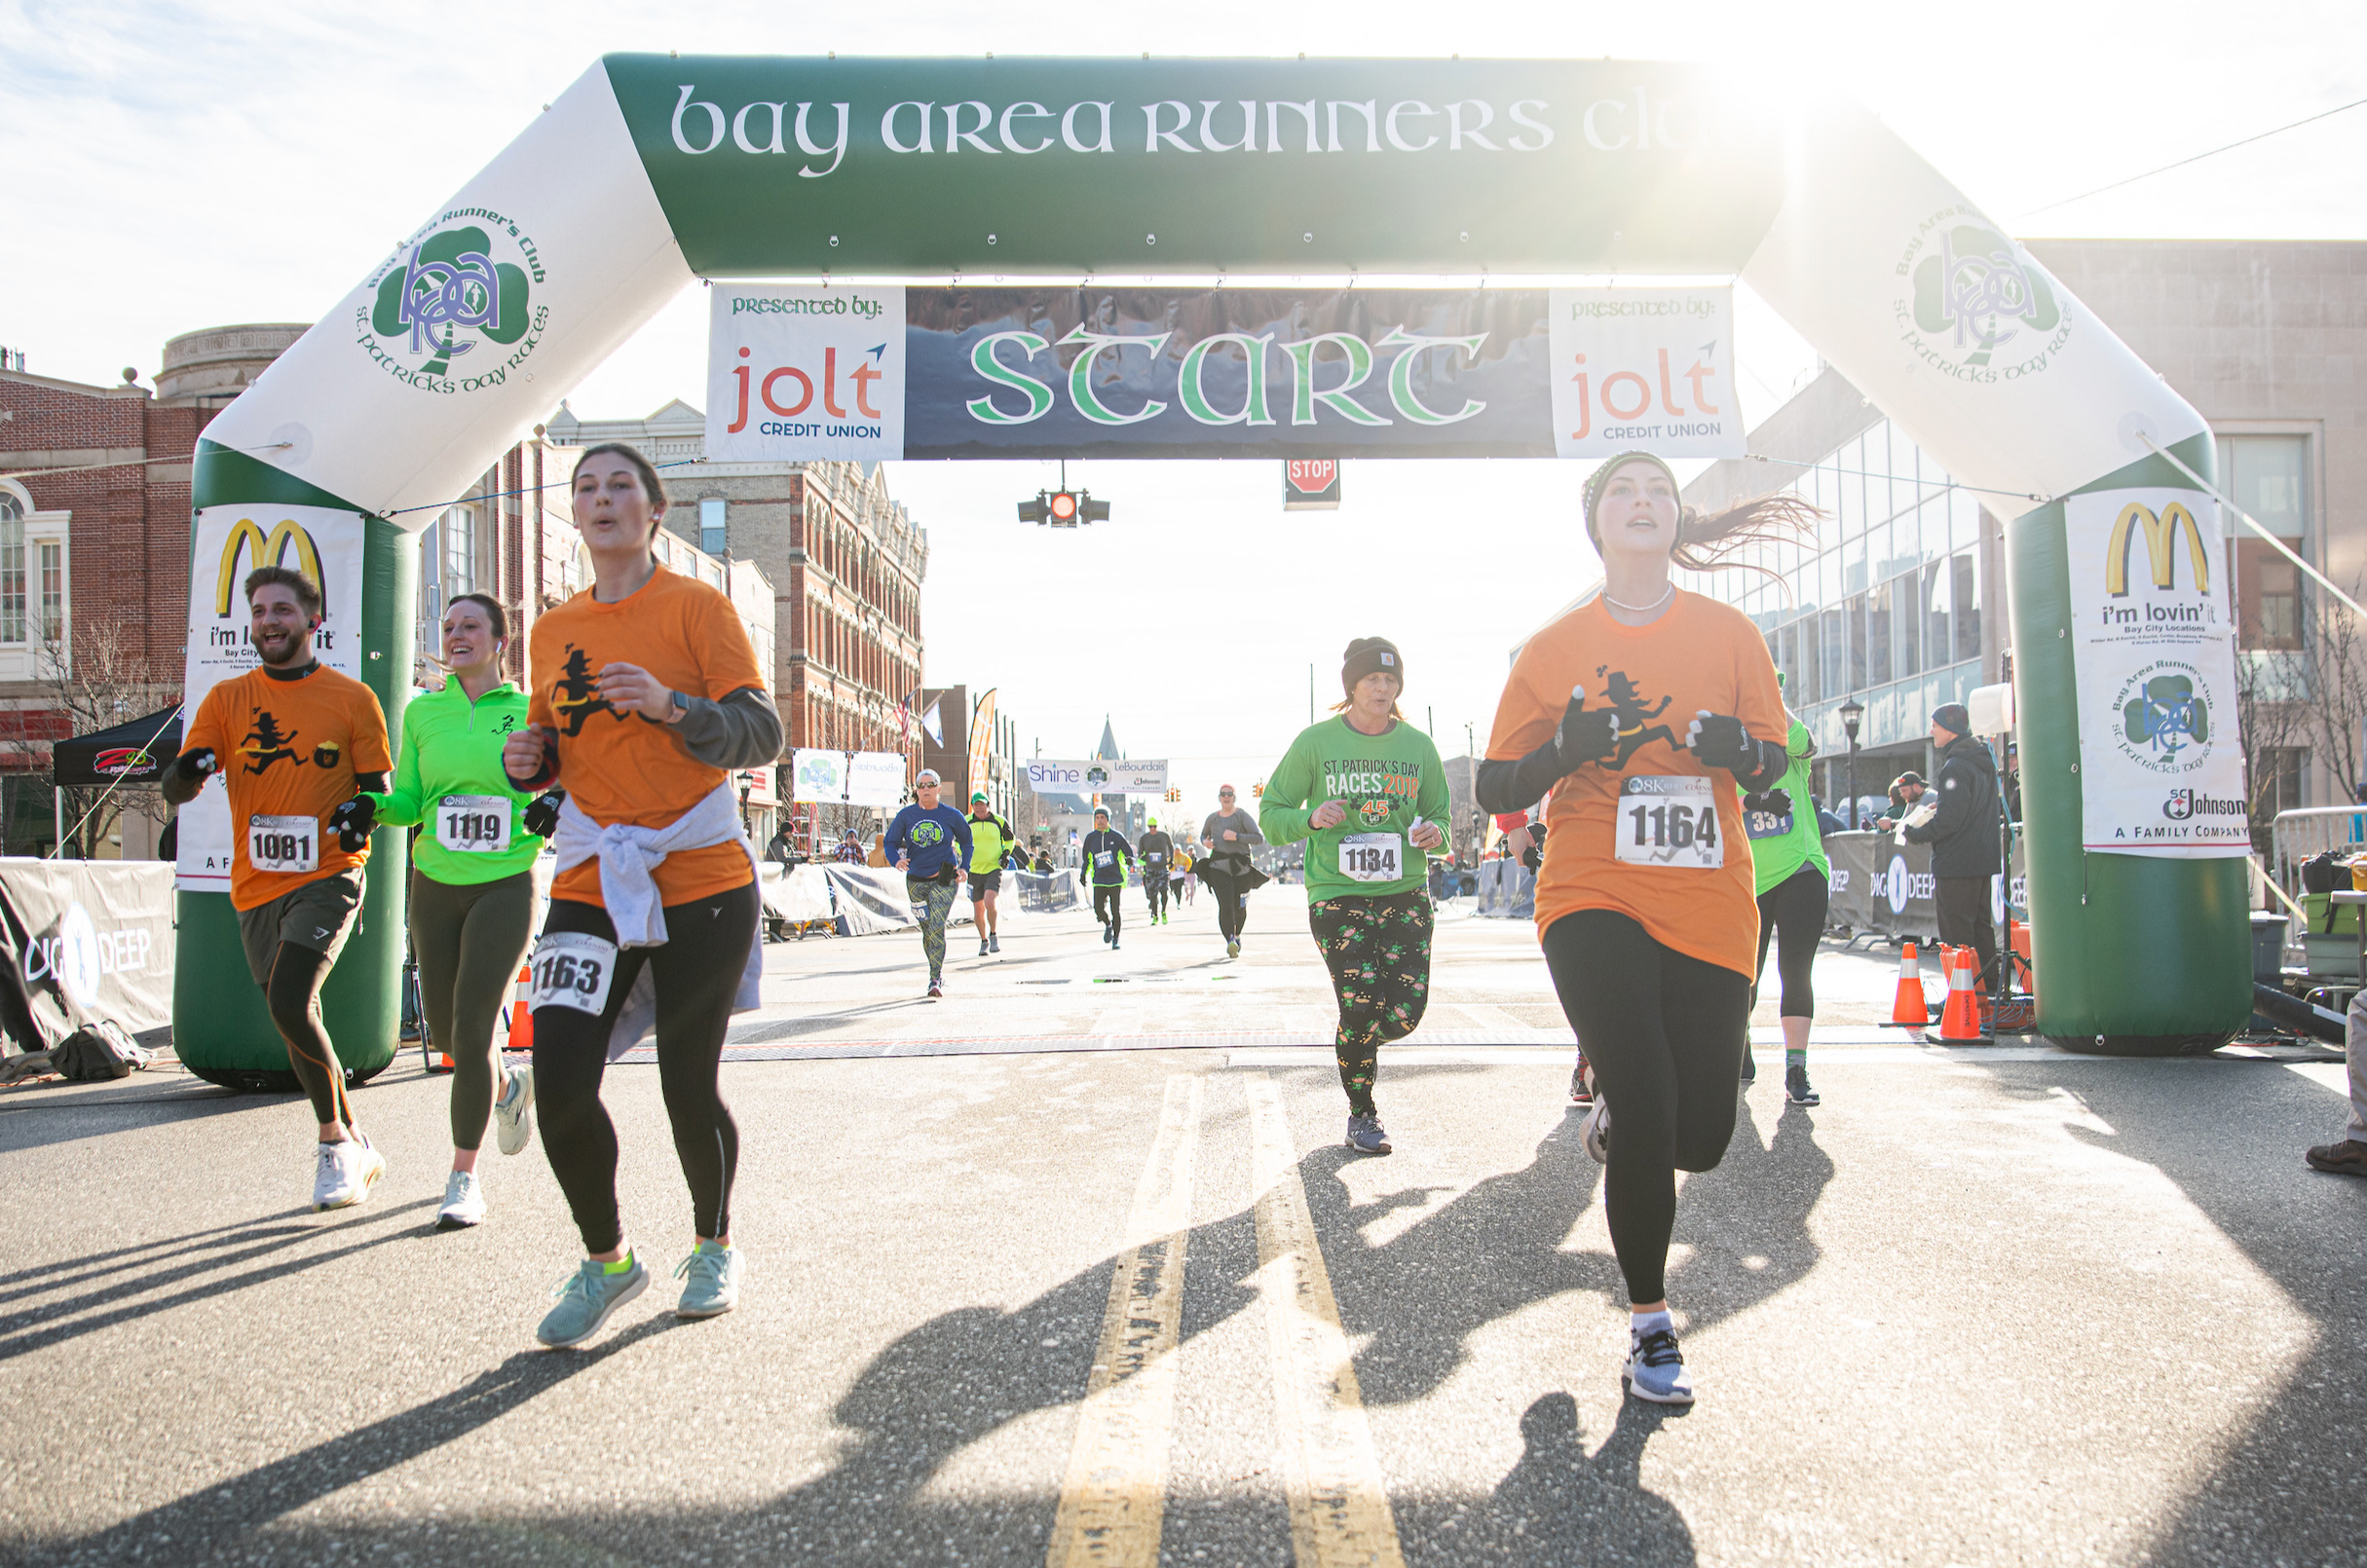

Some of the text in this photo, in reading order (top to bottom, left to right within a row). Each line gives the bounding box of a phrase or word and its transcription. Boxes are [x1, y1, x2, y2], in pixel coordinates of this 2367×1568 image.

[441, 206, 520, 238] Runner's
[518, 236, 546, 284] Club
[1895, 235, 1923, 277] Bay
[1918, 206, 1955, 237] Area
[727, 346, 883, 434] jolt
[1570, 344, 1718, 441] jolt
[760, 421, 882, 439] CREDIT UNION
[1603, 422, 1722, 440] CREDIT UNION
[1292, 460, 1333, 478] STOP
[2103, 602, 2216, 625] i'm lovin' it
[210, 626, 237, 646] i'm
[317, 629, 333, 650] it
[2145, 624, 2163, 634] City
[2165, 623, 2206, 633] Locations
[225, 648, 259, 657] Bay City
[2112, 687, 2130, 711] Bay
[2126, 664, 2154, 688] Area
[2156, 659, 2202, 684] Runner's
[1030, 763, 1080, 783] Shine
[1114, 761, 1166, 772] LeBourdais
[1324, 759, 1420, 778] ST. PATRICK'S DAY
[1326, 772, 1419, 800] RACES 2018
[1643, 779, 1665, 793] 8K
[455, 796, 468, 805] 8K
[1361, 801, 1389, 816] 45
[2162, 788, 2247, 820] SC Johnson
[261, 817, 274, 826] 8K
[446, 813, 501, 840] 1119
[1629, 804, 1716, 849] 1164
[2115, 825, 2249, 839] A FAMILY COMPANY
[253, 833, 310, 861] 1081
[1345, 848, 1396, 872] 1134
[1870, 873, 1936, 899] DIG DEEP
[98, 927, 151, 974] DEEP
[533, 954, 603, 994] 1163
